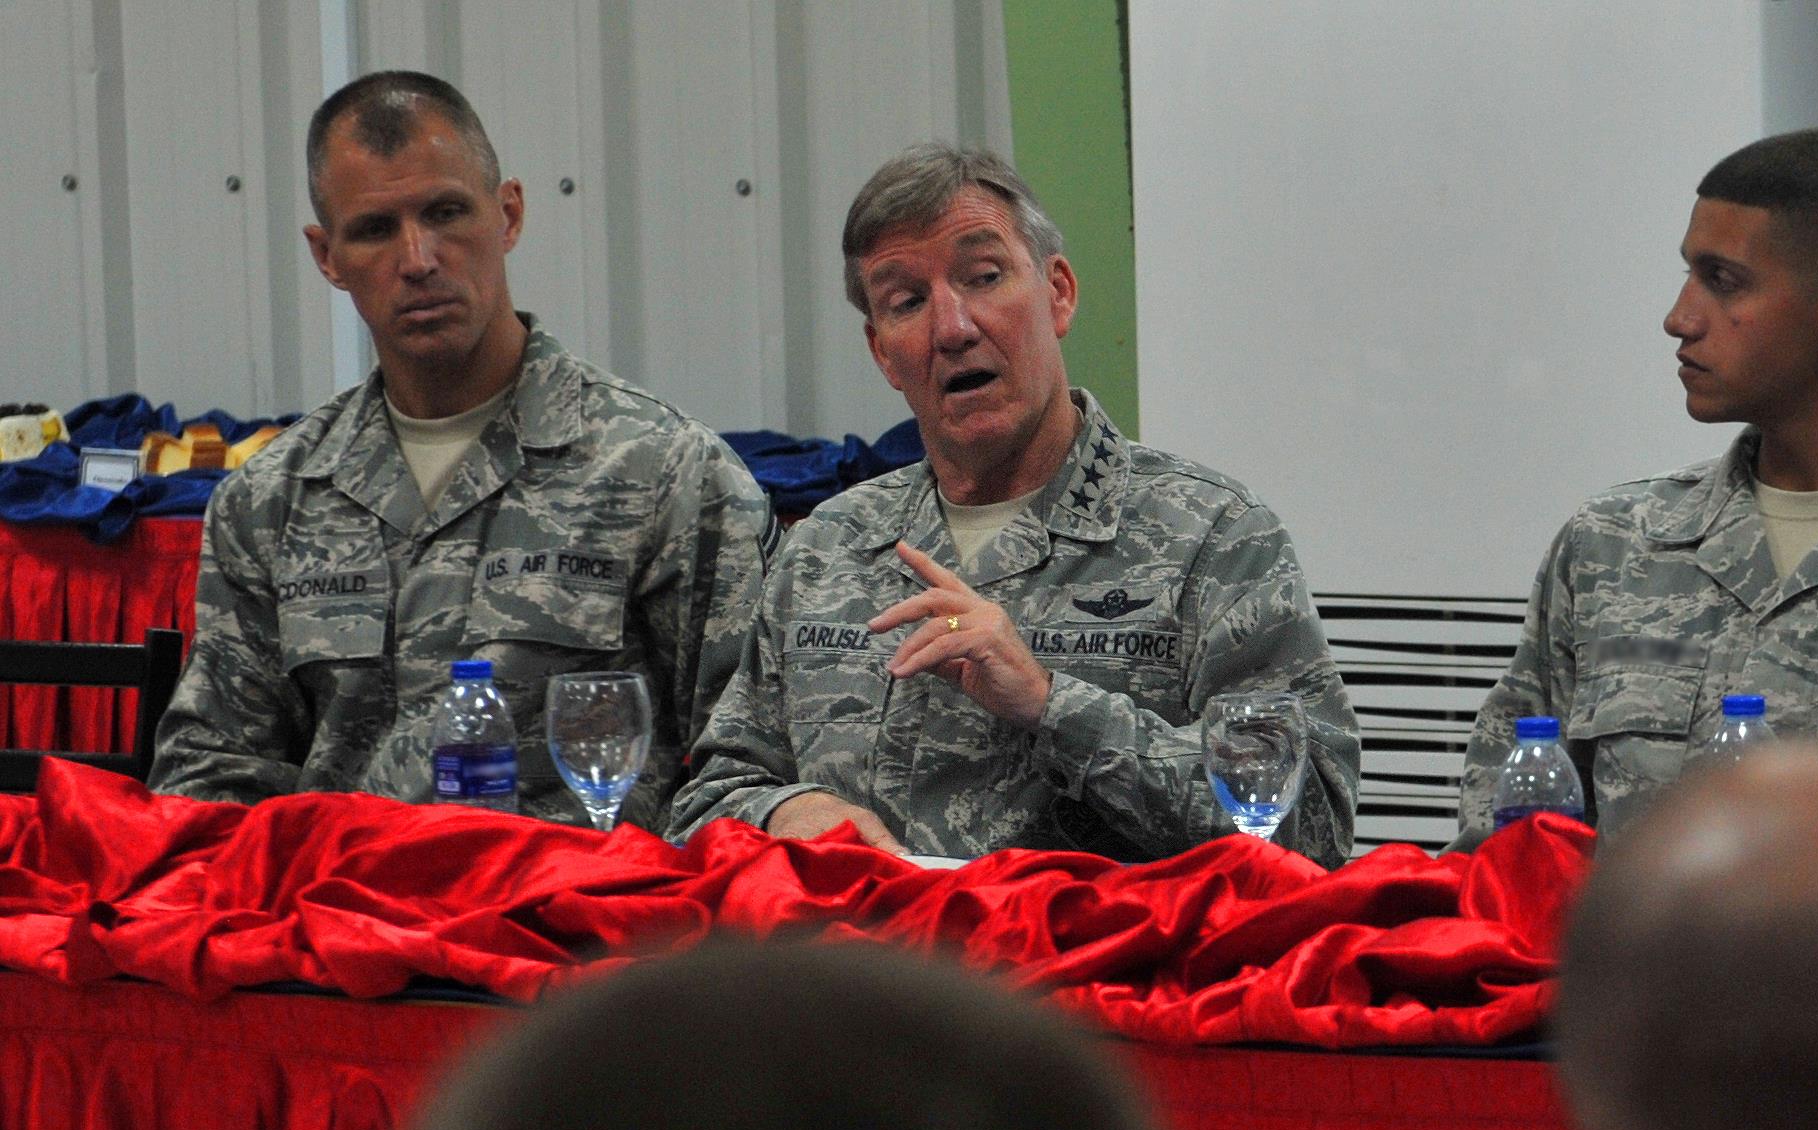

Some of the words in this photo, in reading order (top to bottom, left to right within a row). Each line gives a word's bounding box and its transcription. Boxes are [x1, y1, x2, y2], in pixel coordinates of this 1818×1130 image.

[486, 558, 508, 580] U.S.
[520, 554, 547, 573] AIR
[558, 554, 615, 579] FORCE
[278, 575, 367, 601] CDONALD
[797, 625, 871, 650] CARLISLE
[1031, 631, 1066, 654] U.S.
[1074, 632, 1108, 654] AIR
[1113, 630, 1177, 660] FORCE
